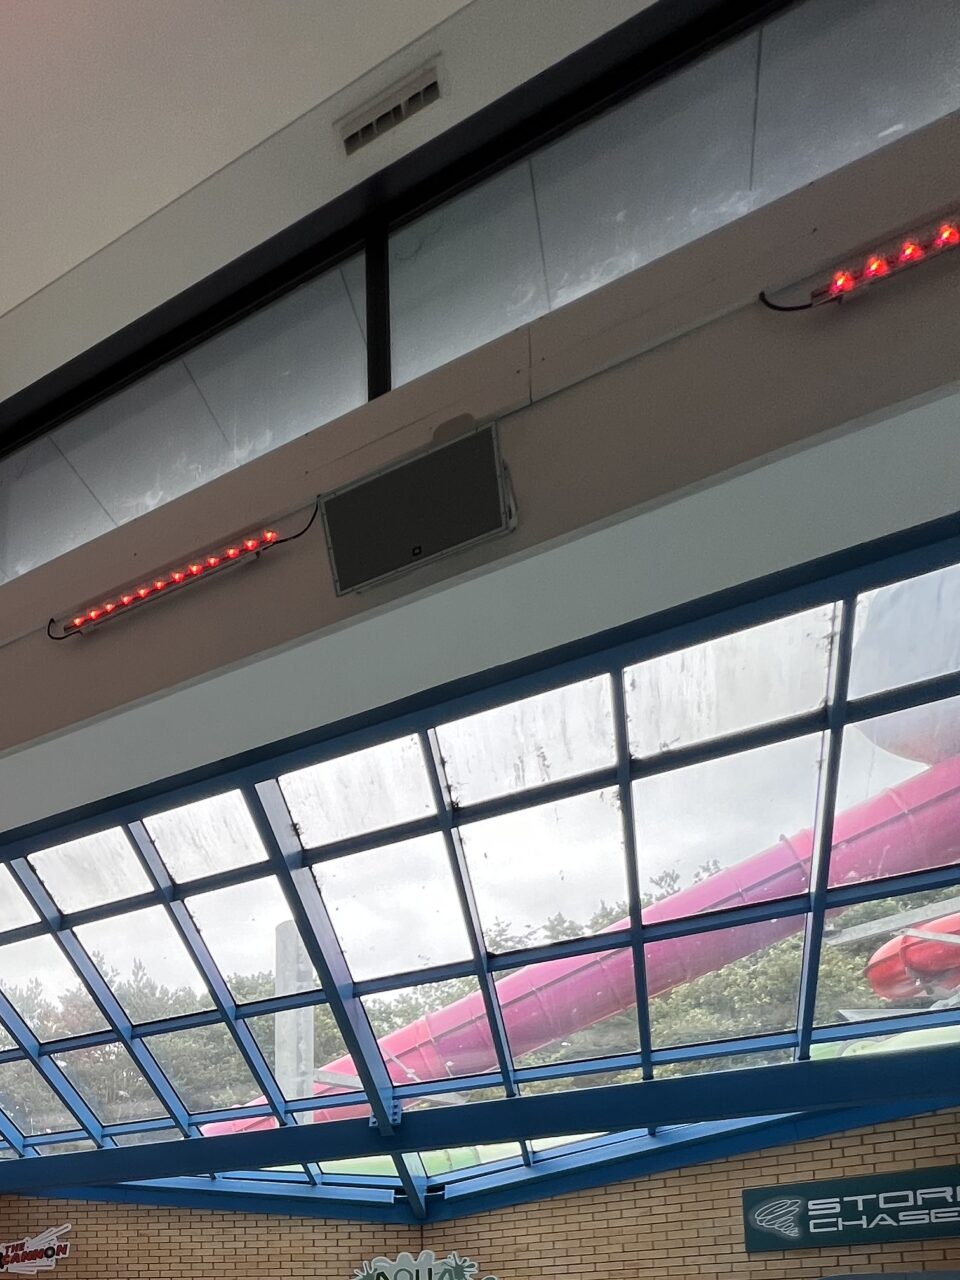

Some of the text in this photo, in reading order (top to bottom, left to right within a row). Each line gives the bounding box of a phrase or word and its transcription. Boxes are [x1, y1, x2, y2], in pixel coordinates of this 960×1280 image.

[808, 1185, 960, 1216] STOR
[2, 1243, 68, 1265] CANNON
[4, 1242, 26, 1254] THE
